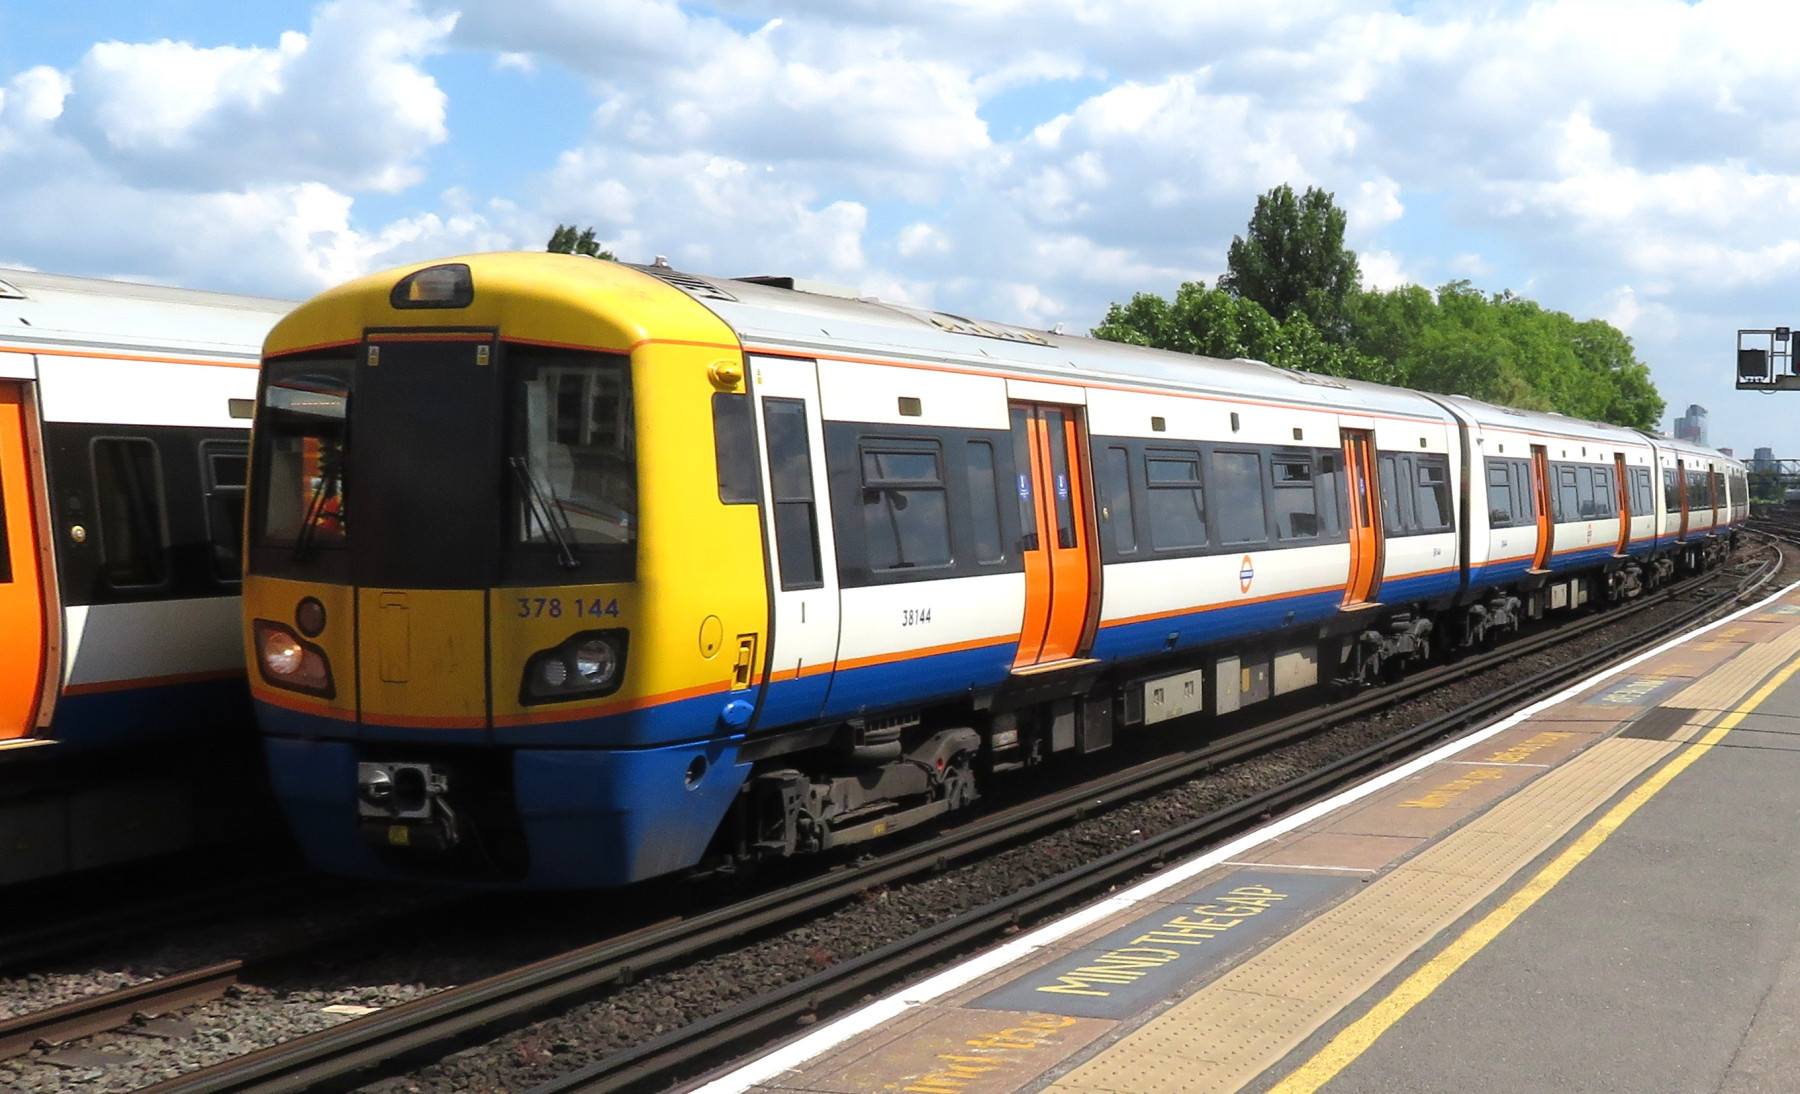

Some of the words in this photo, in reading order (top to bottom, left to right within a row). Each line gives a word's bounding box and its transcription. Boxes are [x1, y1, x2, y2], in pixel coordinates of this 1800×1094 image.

[518, 598, 562, 618] 378
[575, 598, 620, 618] 144
[902, 607, 931, 626] 38144
[1035, 947, 1181, 997] MIND
[1130, 915, 1244, 945] THE
[1192, 884, 1289, 917] GAP
